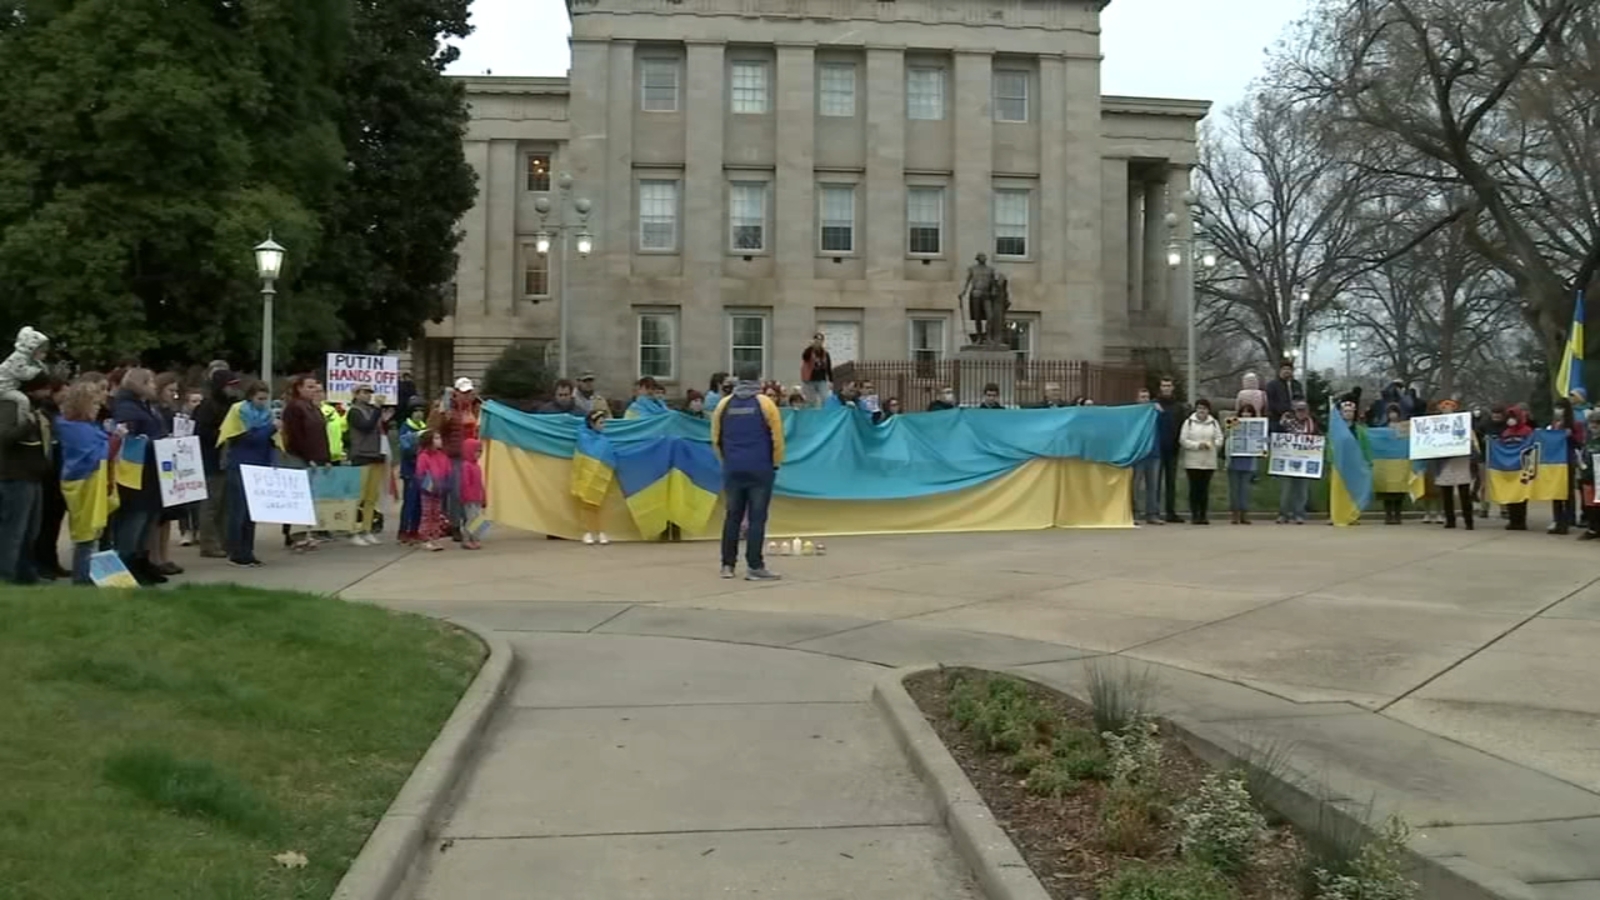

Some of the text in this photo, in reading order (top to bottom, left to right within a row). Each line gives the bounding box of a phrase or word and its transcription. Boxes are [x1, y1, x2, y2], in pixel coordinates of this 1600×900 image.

[334, 354, 384, 370] PUTIN
[329, 370, 397, 384] HANDS OFF
